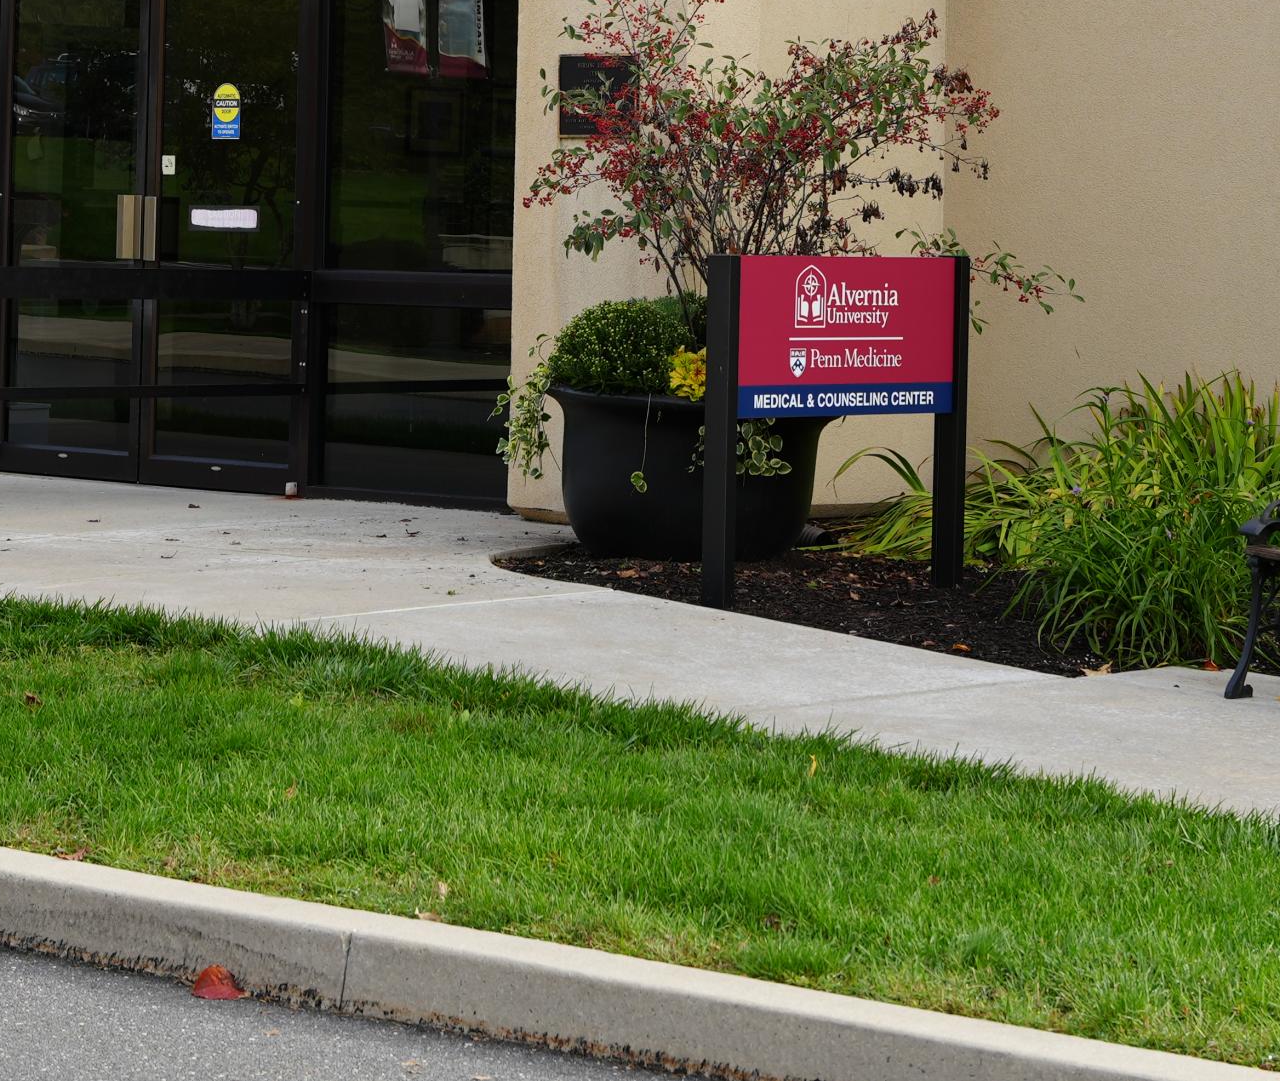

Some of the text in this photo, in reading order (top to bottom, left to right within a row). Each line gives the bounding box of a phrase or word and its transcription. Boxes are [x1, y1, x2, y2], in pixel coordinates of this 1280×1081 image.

[827, 282, 898, 306] Alvernia
[827, 307, 889, 328] University
[810, 347, 902, 368] Penn Medicine
[753, 391, 934, 408] MEDICAL & COUNSELING CENTER
